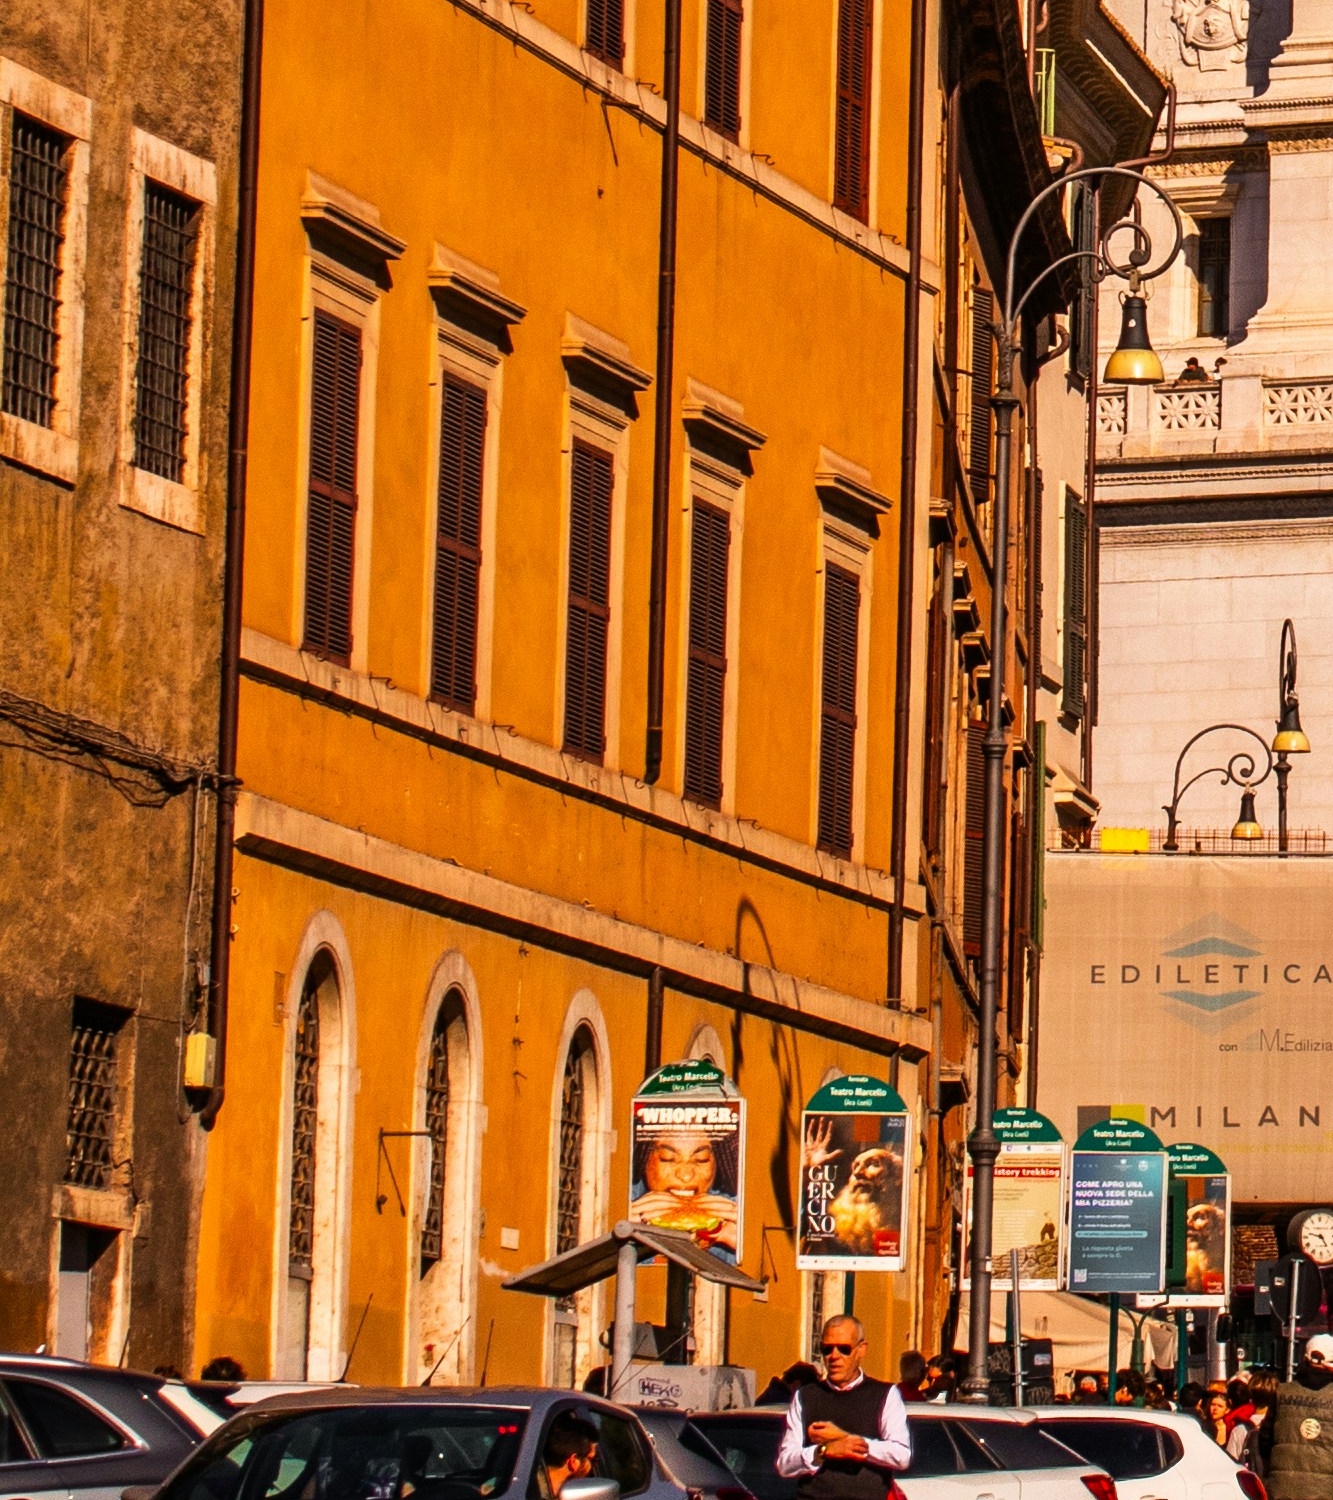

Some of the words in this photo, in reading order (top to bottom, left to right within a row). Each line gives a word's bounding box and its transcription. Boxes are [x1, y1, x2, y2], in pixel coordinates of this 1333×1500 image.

[1091, 964, 1333, 984] EDILETICA
[1219, 1042, 1238, 1051] con
[1260, 1029, 1333, 1051] M.Edilizia
[659, 1074, 682, 1083] Teatro
[684, 1072, 719, 1081] Marcello
[830, 1087, 854, 1096] Teatro
[855, 1087, 887, 1097] Marcello
[993, 1120, 1011, 1128] eatro
[1013, 1120, 1043, 1128] Marcello
[1093, 1130, 1114, 1138] Teatro
[1116, 1130, 1145, 1138] Marcello
[808, 1165, 838, 1181] GU
[995, 1167, 1020, 1177] istory
[1022, 1167, 1060, 1177] trekking
[807, 1182, 835, 1199] ER
[807, 1199, 827, 1216] CI
[808, 1216, 836, 1233] NO
